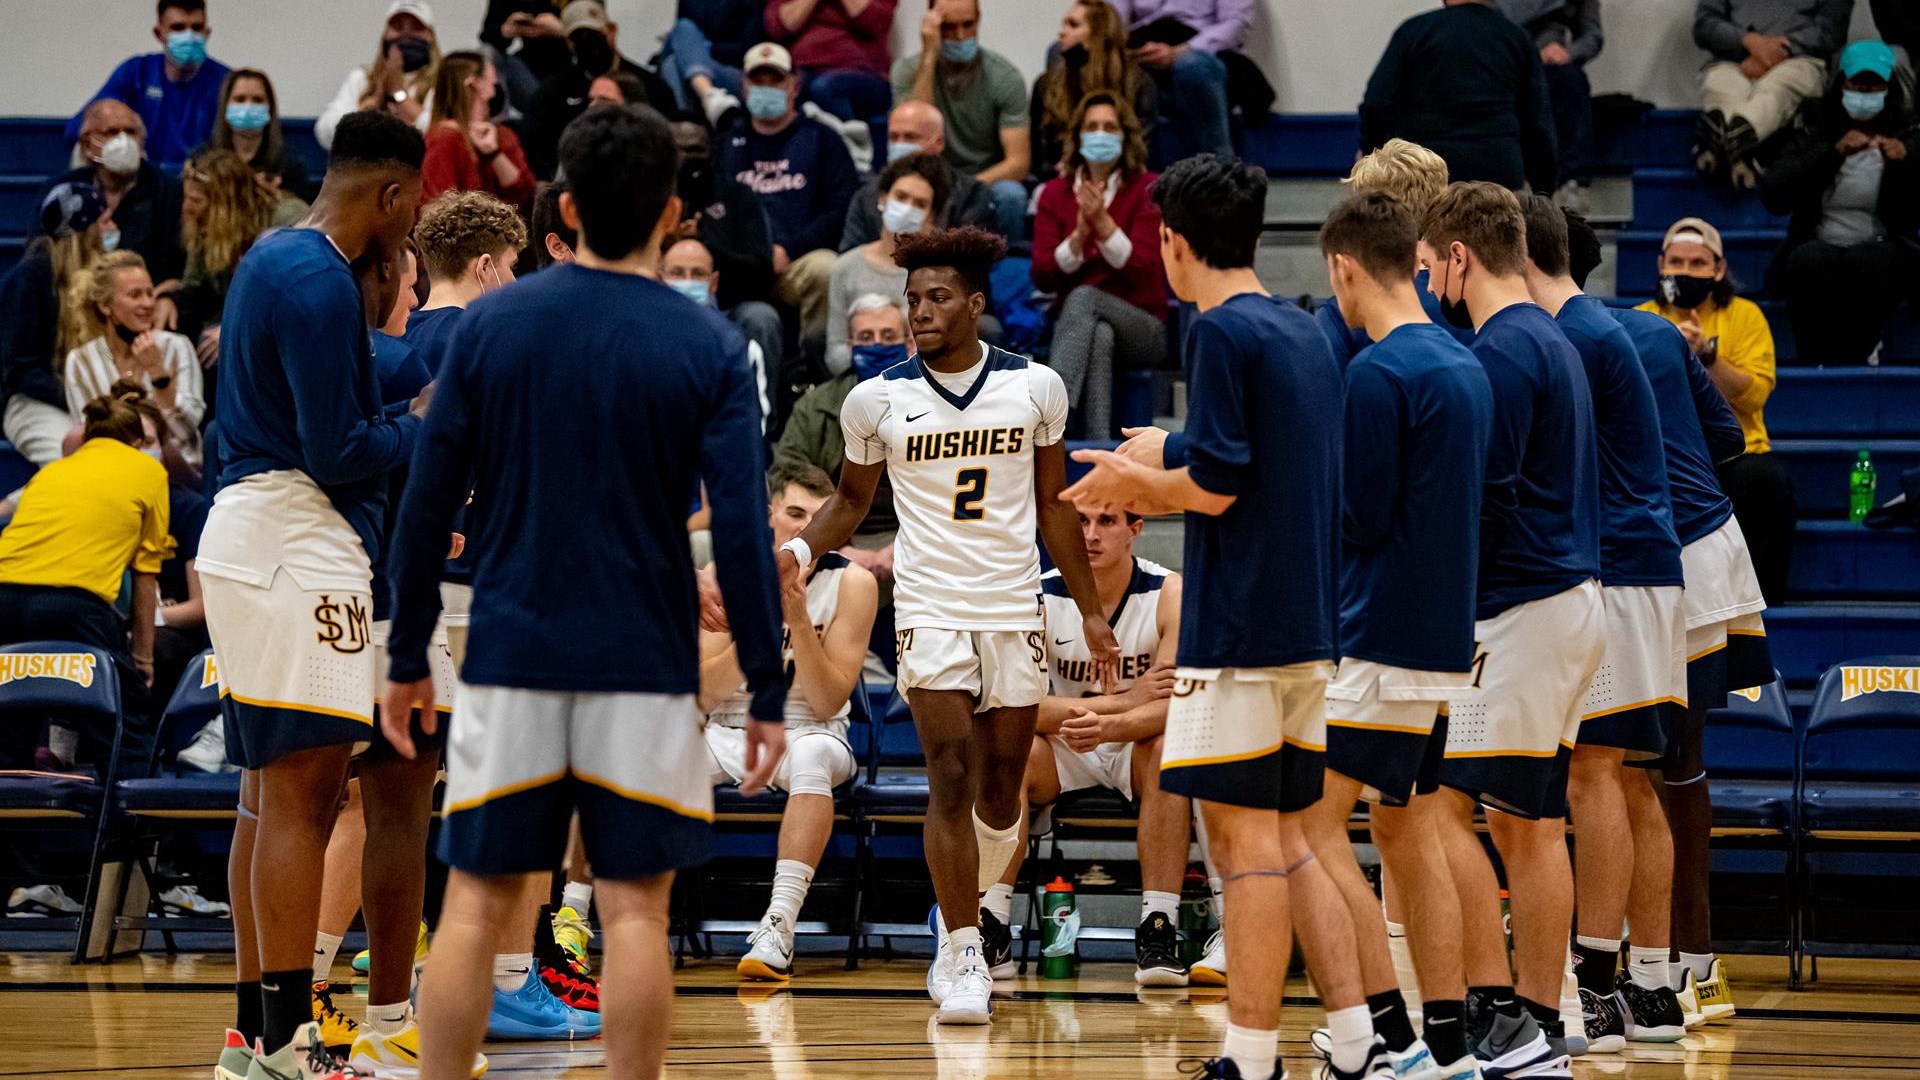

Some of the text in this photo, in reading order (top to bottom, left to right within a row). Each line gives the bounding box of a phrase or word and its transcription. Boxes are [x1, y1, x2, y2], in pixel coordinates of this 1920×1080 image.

[905, 427, 1025, 462] HUSKIES
[952, 466, 990, 522] 2
[0, 654, 96, 687] HUSKIES
[1057, 653, 1151, 682] HUSES
